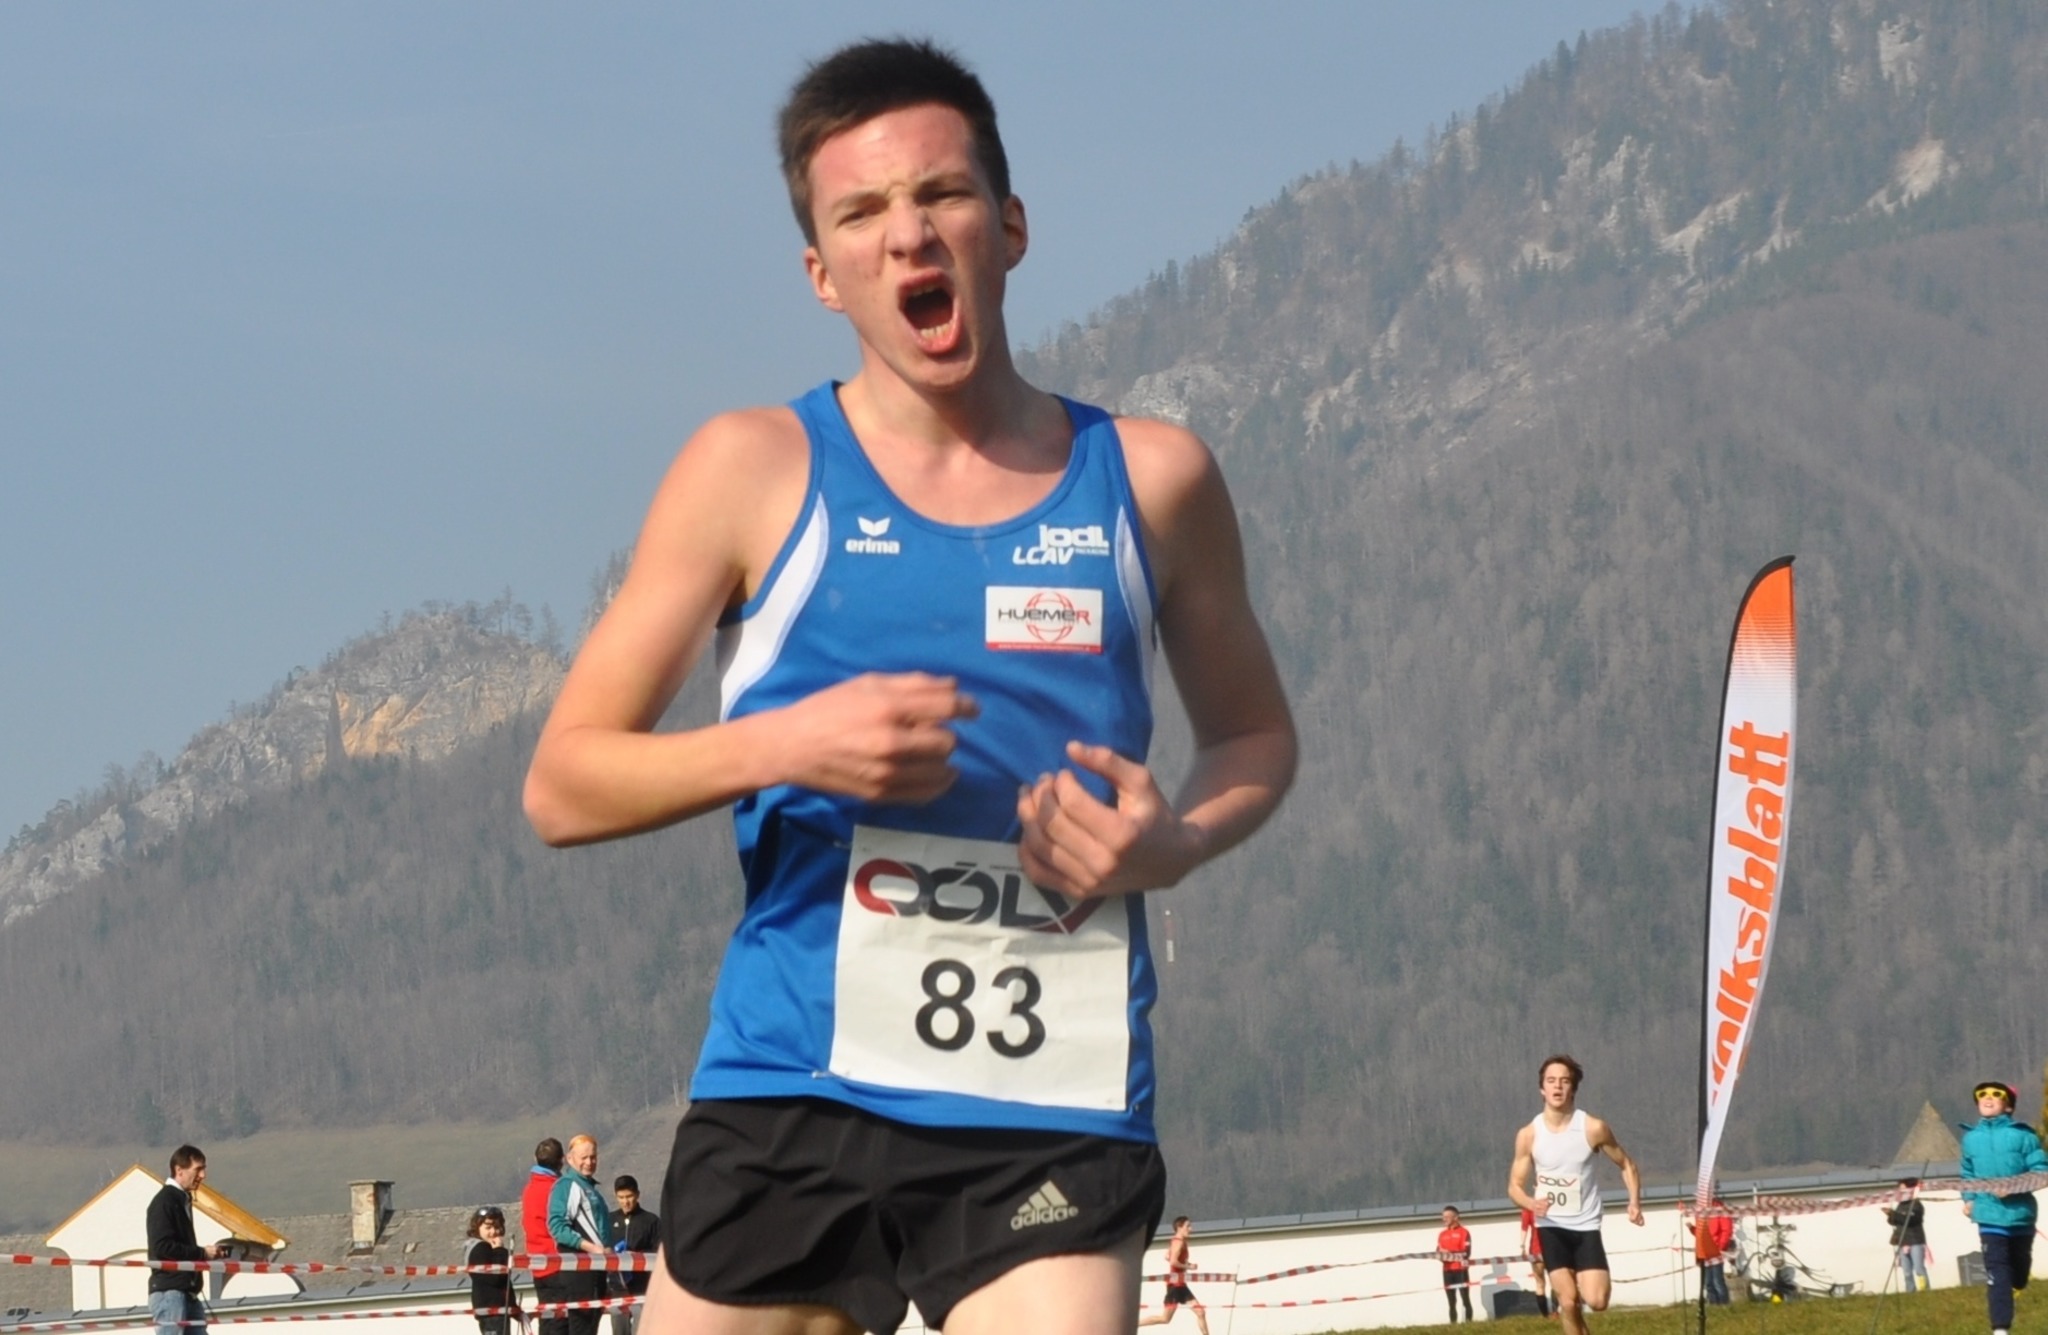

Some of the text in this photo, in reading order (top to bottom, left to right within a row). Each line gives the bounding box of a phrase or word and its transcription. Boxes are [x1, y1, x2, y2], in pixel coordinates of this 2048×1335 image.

[846, 538, 900, 554] erima
[1012, 546, 1074, 565] LCAV
[915, 959, 1046, 1059] 83
[1547, 1191, 1567, 1207] 90
[1010, 1206, 1079, 1231] adidas
